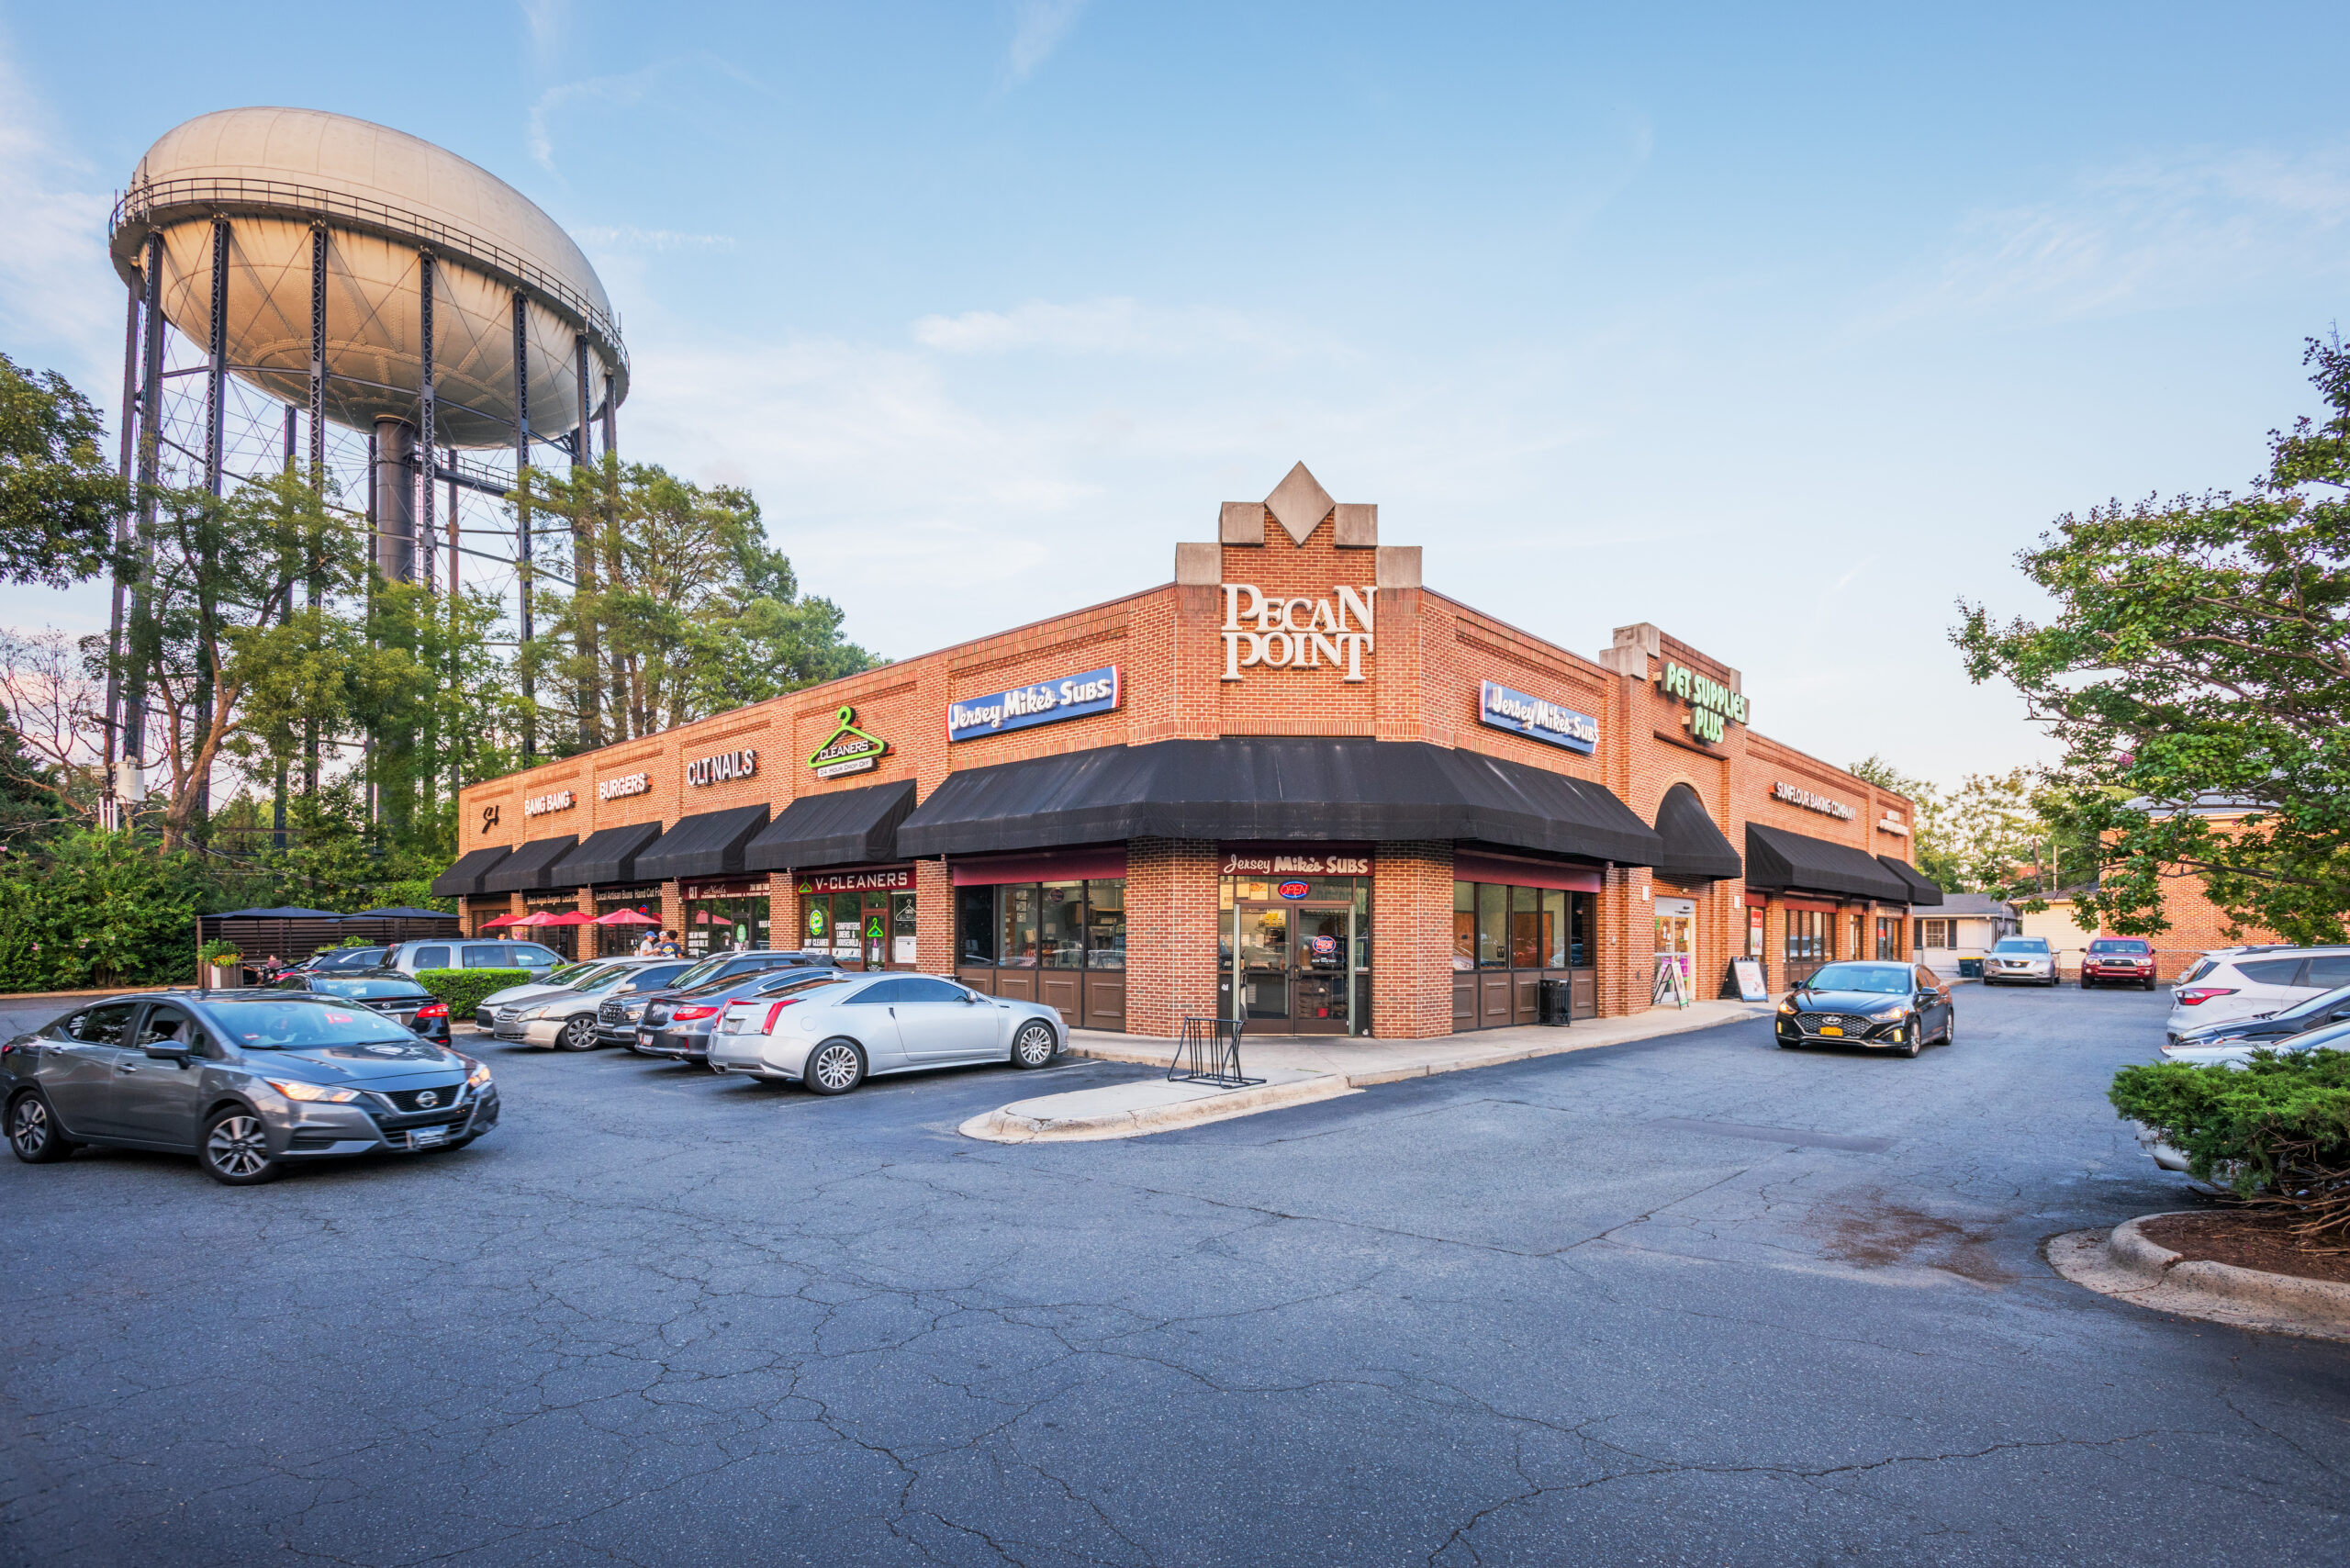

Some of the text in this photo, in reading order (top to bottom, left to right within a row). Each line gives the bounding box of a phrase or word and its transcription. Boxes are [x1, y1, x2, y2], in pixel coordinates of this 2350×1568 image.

[1221, 584, 1378, 633] PECAN
[1221, 632, 1374, 681] POINT
[1666, 662, 1746, 723] PET SUPPLIES
[949, 704, 1002, 729] Jersey
[1489, 686, 1536, 731] Jersey
[1695, 706, 1725, 744] PLUS
[820, 740, 868, 760] CLEANERS
[688, 749, 754, 786] CLT NAILS
[599, 772, 645, 799] BURGERS
[525, 790, 569, 816] BANG BANG
[1776, 781, 1856, 822] SUNFLOUR BAKING COMPANY
[1224, 854, 1270, 874] Jersey
[1274, 856, 1325, 872] Mike's
[634, 889, 646, 898] Hand
[688, 886, 698, 899] CLT
[815, 872, 908, 890] V-CLEANERS
[1280, 885, 1308, 895] OPEN
[607, 890, 621, 900] Artisan
